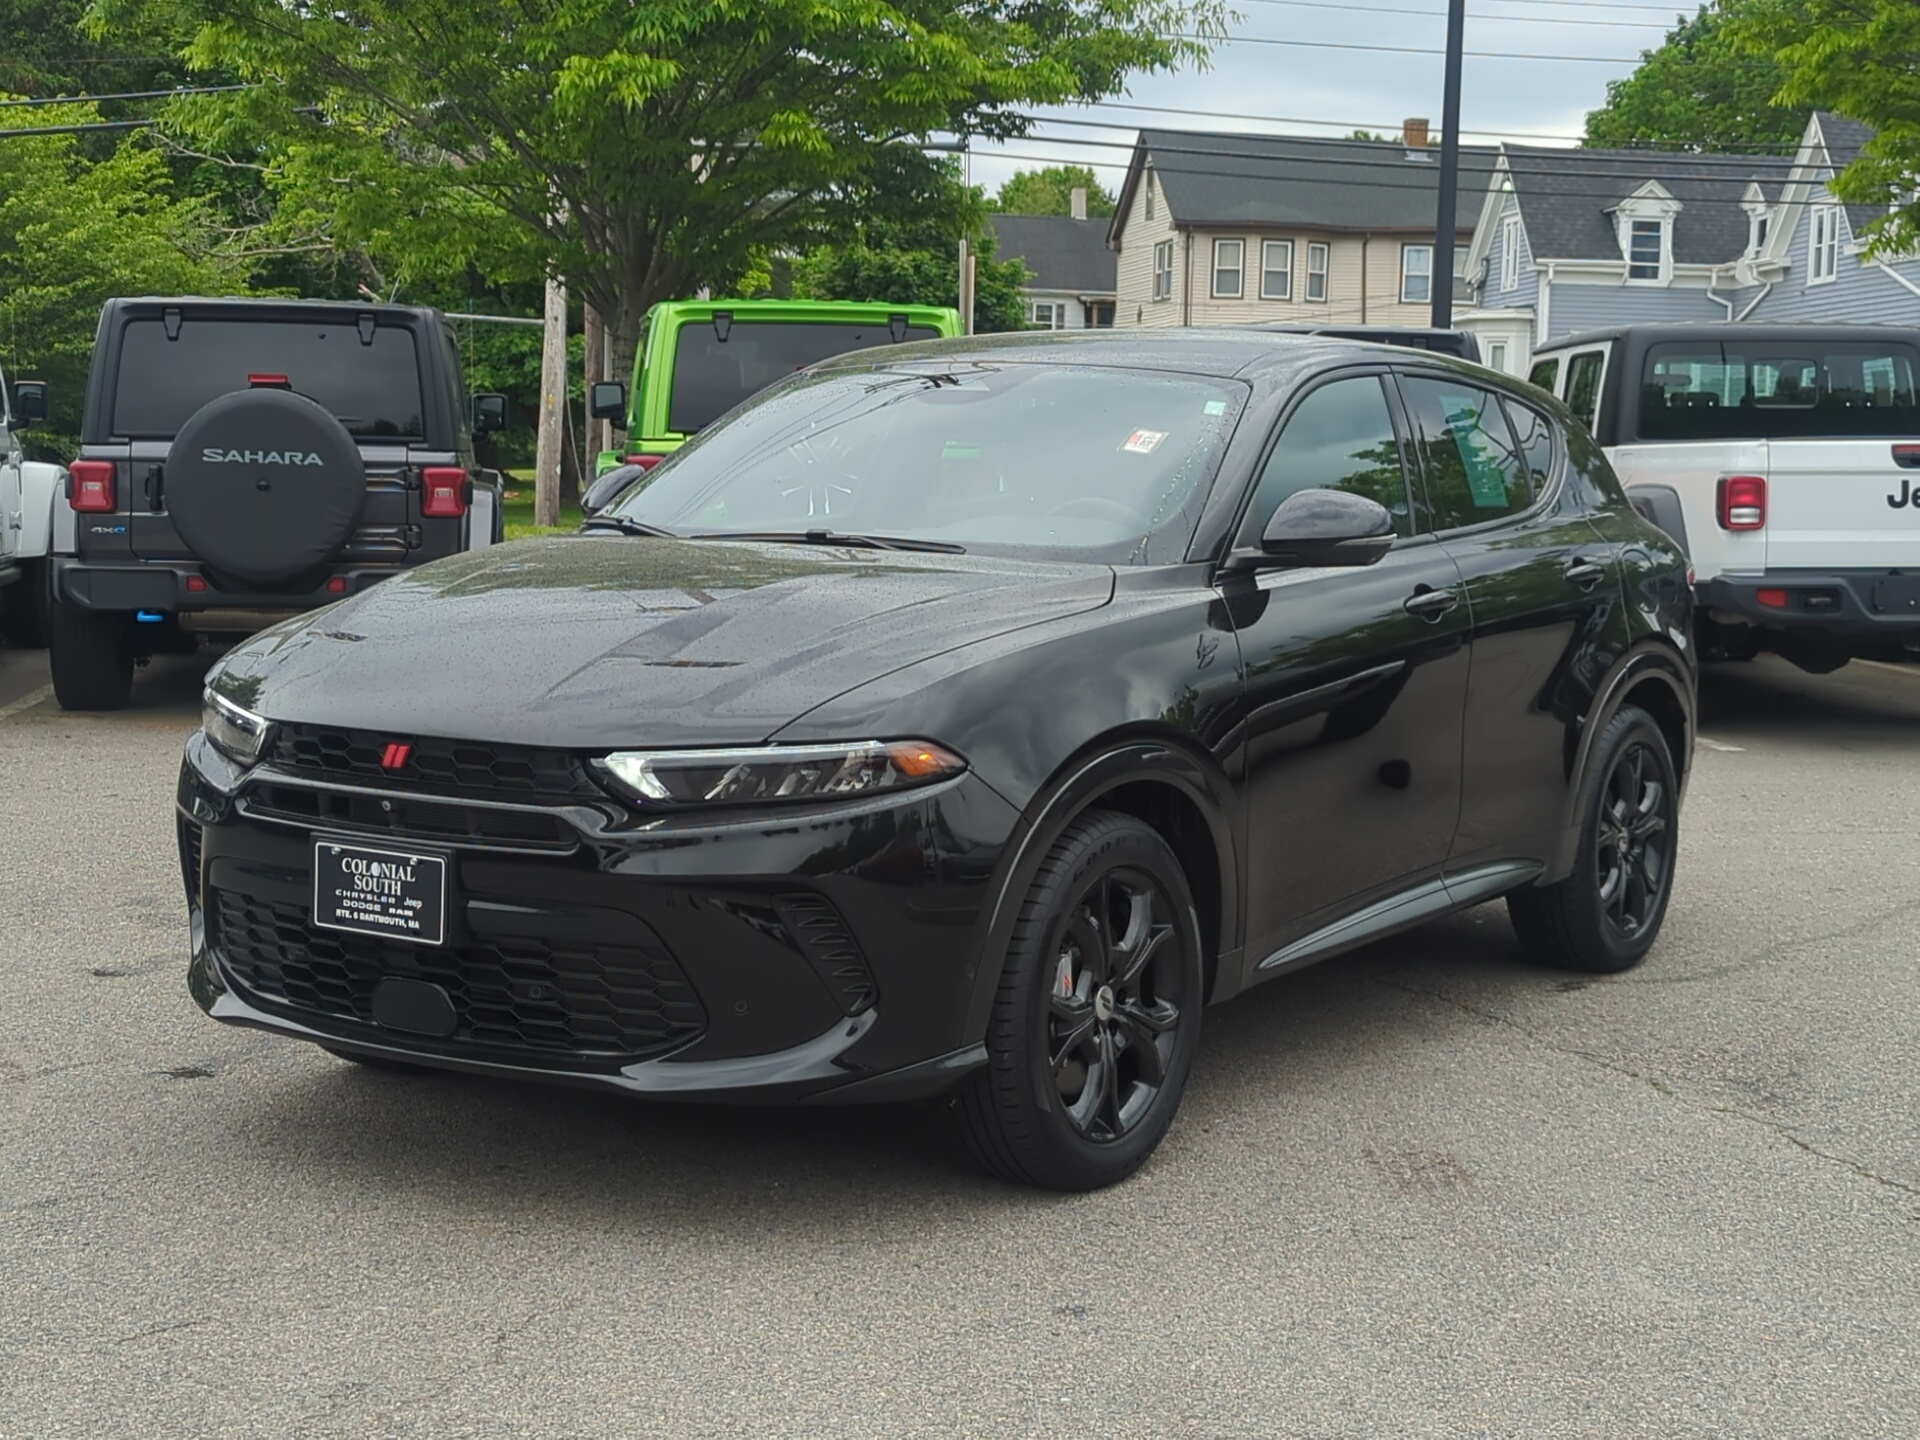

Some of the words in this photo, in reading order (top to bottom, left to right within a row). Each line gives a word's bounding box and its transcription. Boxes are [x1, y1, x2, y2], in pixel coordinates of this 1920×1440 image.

[202, 448, 324, 466] SAHARA
[341, 857, 416, 882] COLONIAL
[354, 874, 402, 896] SOUTH
[335, 889, 396, 904] CHRYSLER
[403, 896, 423, 910] Jeep
[343, 899, 382, 912] DODGE
[388, 907, 414, 917] RAM
[335, 908, 352, 919] RTE.
[353, 911, 359, 919] 6
[359, 912, 407, 929] DARTMOUTH,
[407, 919, 420, 929] MA
